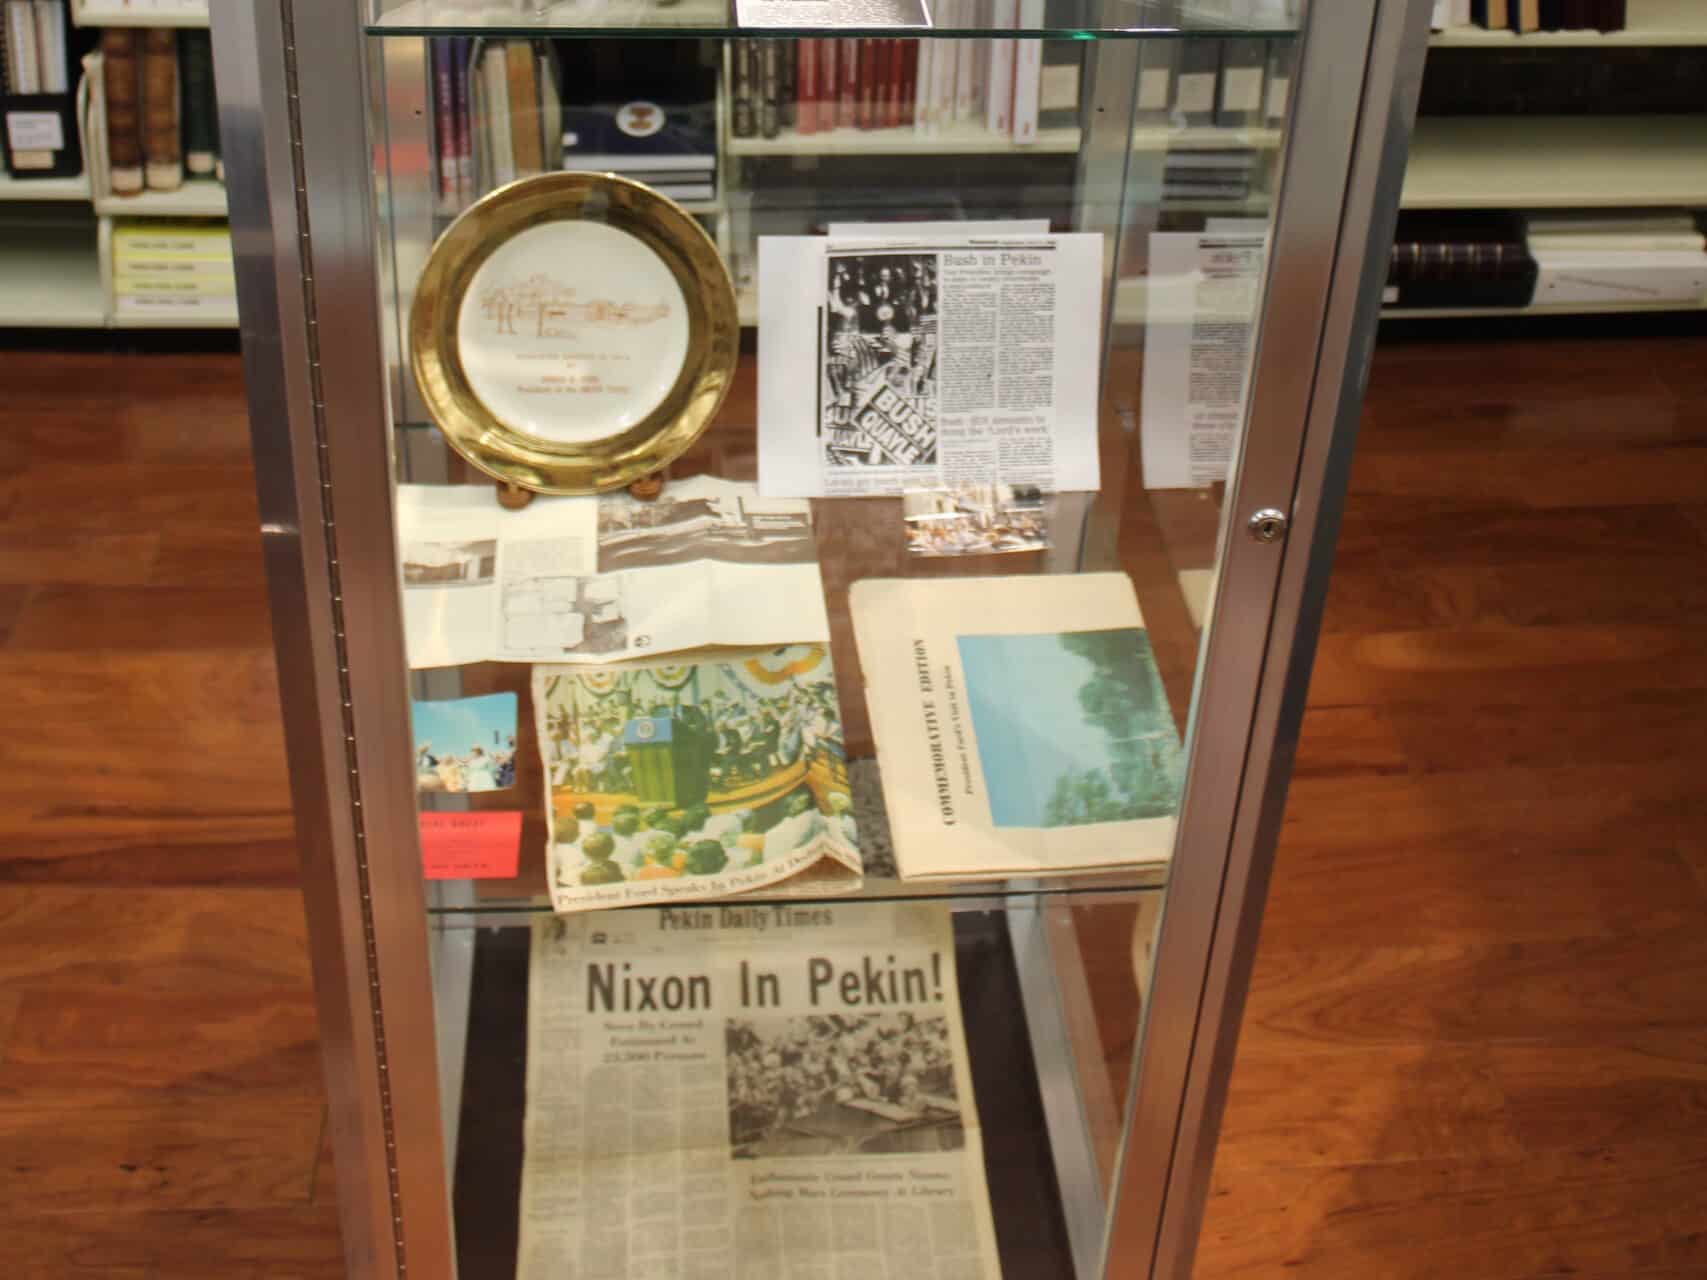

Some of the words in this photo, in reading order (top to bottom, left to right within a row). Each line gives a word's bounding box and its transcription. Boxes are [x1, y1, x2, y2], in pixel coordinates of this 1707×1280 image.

[944, 253, 977, 266] Bush
[982, 254, 995, 266] in
[1000, 253, 1042, 266] Pekin
[861, 410, 919, 464] QUAYLE
[875, 389, 936, 450] BUSH
[914, 639, 932, 692] EDITION
[922, 701, 956, 826] COMMEMORATIVE
[557, 890, 621, 906] President
[625, 886, 656, 900] Ford
[659, 907, 713, 931] Pekin
[719, 906, 768, 932] Daily
[773, 905, 833, 928] Times
[586, 962, 712, 1014] Nixon
[739, 960, 781, 1008] In
[808, 952, 945, 1006] Pekin!
